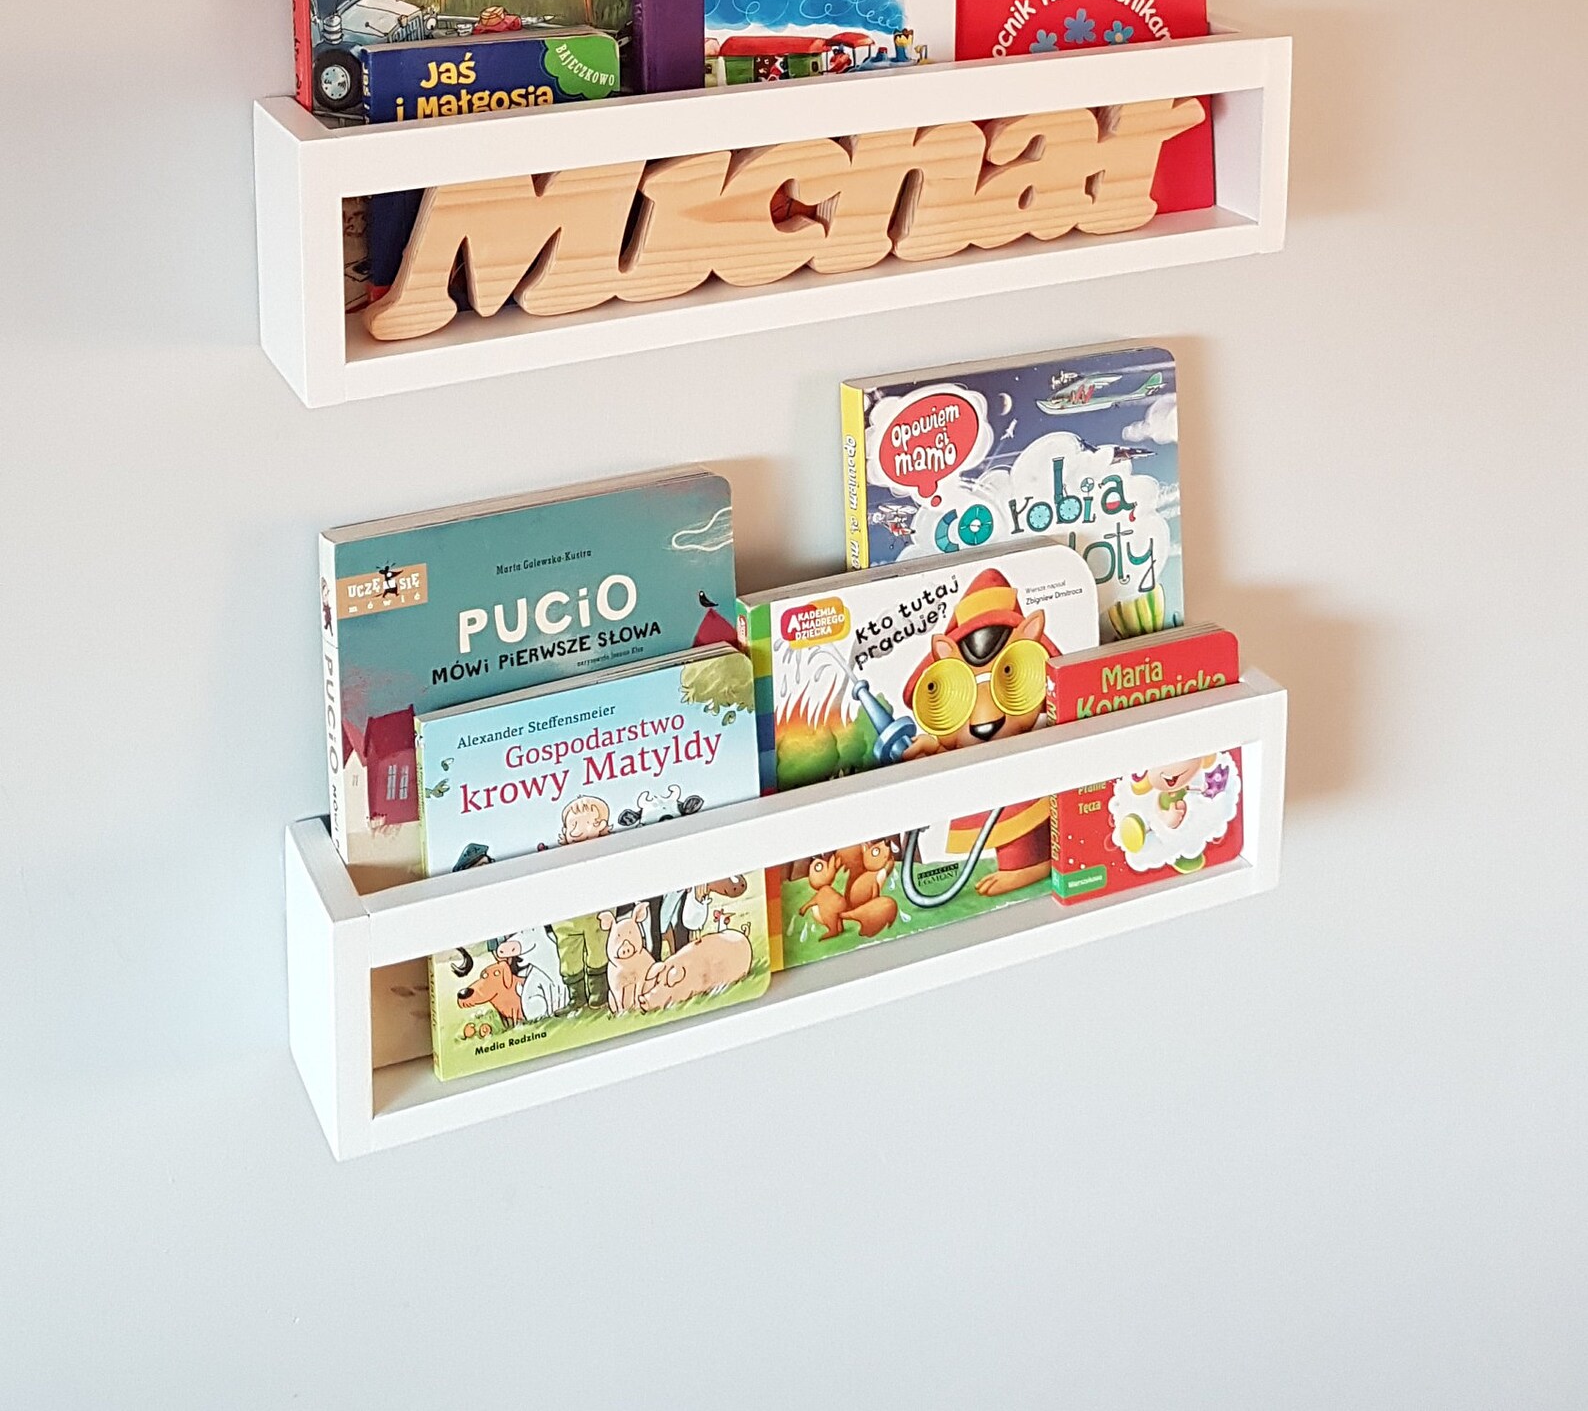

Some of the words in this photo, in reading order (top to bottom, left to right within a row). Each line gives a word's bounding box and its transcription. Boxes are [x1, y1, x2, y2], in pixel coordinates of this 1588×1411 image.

[555, 43, 615, 87] BAJECZKOWO
[891, 403, 960, 450] opowiem
[935, 427, 949, 451] ci
[894, 441, 957, 477] mamo
[1008, 457, 1138, 535] robią
[496, 563, 521, 575] Marta
[523, 549, 592, 571] Galewska-Kustra
[347, 577, 381, 598] UCZĘ
[399, 572, 420, 591] SIĘ
[898, 575, 960, 618] tutaj
[1025, 594, 1053, 606] Zbigniew
[597, 621, 662, 648] SŁOWA
[787, 607, 837, 634] AKADEMIA
[795, 626, 833, 641] DZIECKA
[801, 613, 845, 630] MĄDREGO
[854, 602, 947, 671] pracuje?
[1102, 657, 1163, 694] Maria
[457, 726, 524, 750] Alexander
[528, 704, 616, 734] Steffensmeier
[505, 713, 685, 770] Gospodarstwo
[460, 768, 570, 815] krowy
[582, 730, 723, 786] Matyldy
[474, 1041, 505, 1056] Media
[508, 1031, 547, 1046] Rodzina
